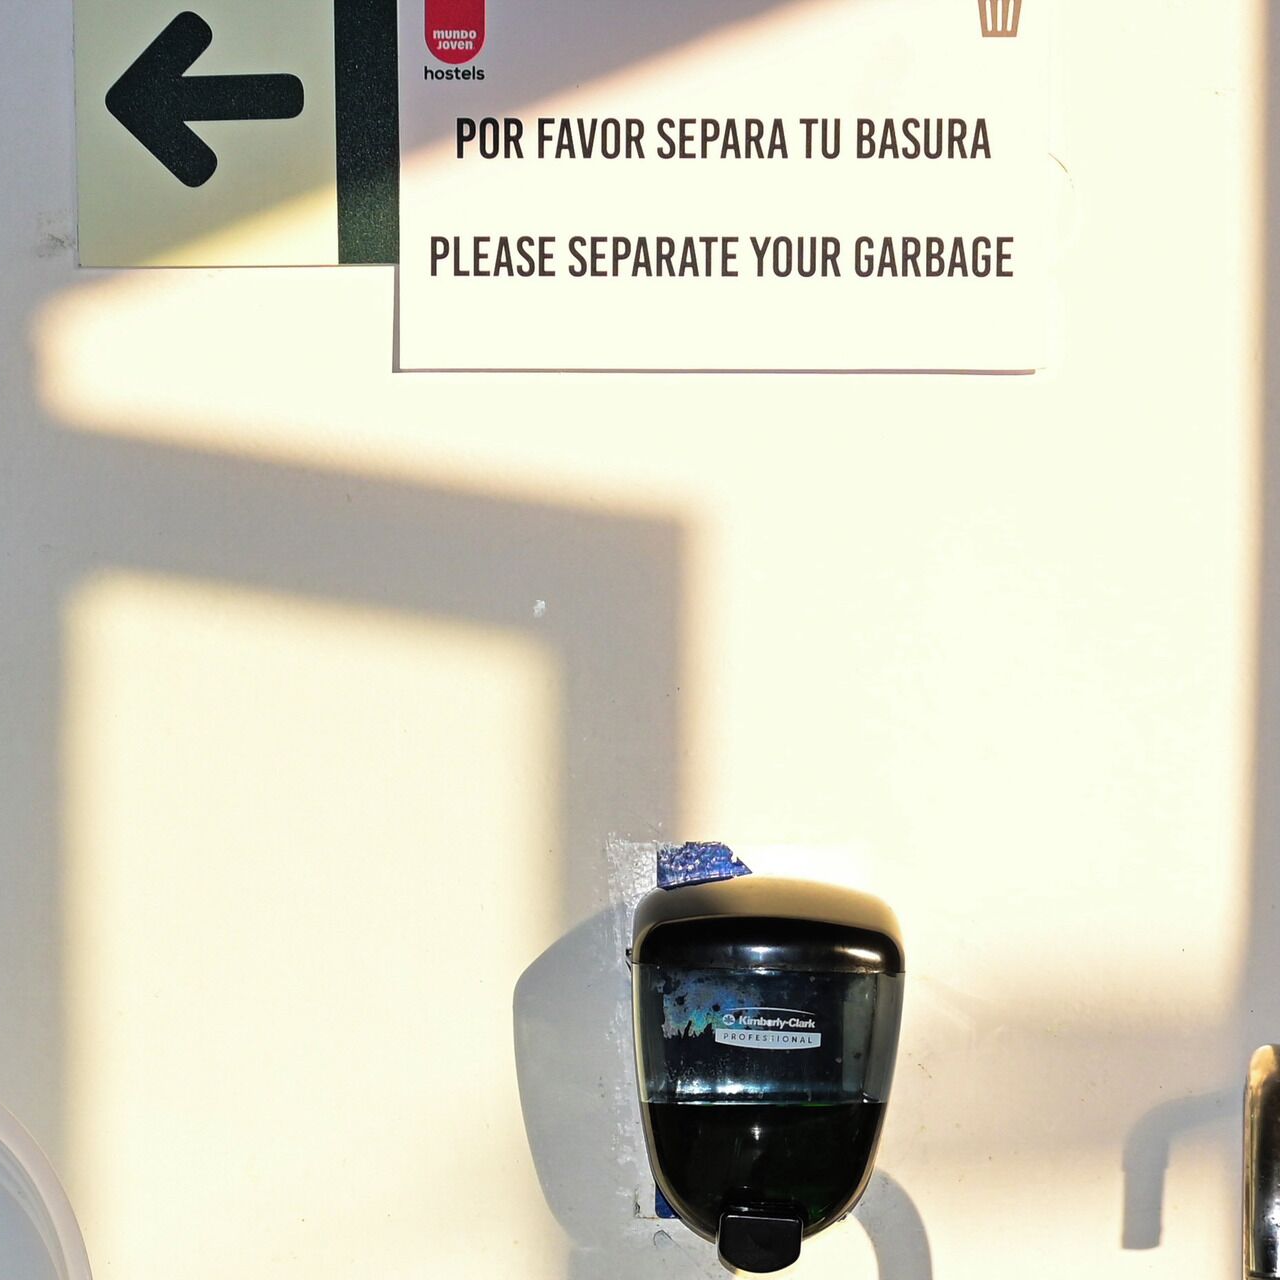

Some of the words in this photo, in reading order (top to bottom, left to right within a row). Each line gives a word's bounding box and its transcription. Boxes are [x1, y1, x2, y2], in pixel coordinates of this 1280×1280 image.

[424, 65, 485, 80] hostels
[455, 117, 525, 160] POR
[537, 117, 645, 159] FAVOR
[657, 117, 788, 159] SEPARA
[799, 118, 840, 159] TU
[856, 117, 991, 159] BASURA
[430, 235, 555, 277] PLEASE
[568, 235, 739, 277] SEPARATE
[749, 236, 841, 277] YOUR
[854, 236, 1013, 277] GARBAGE
